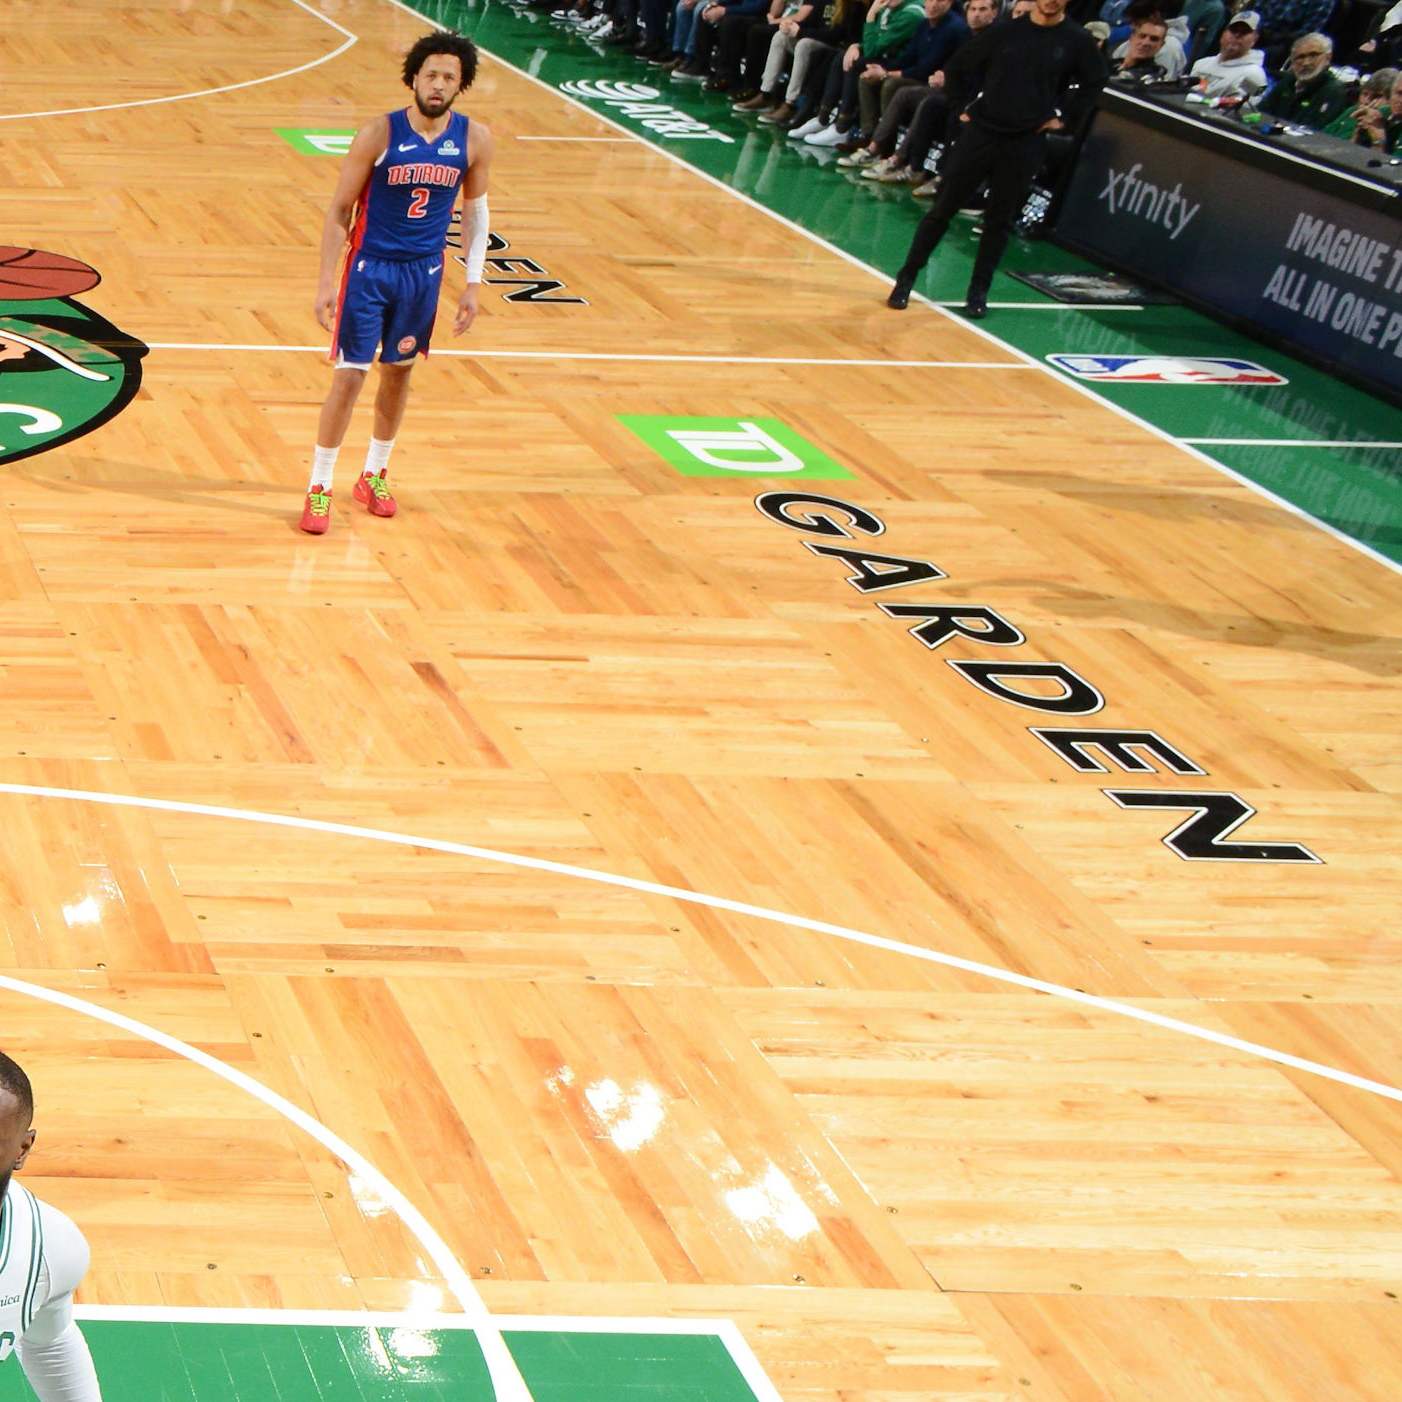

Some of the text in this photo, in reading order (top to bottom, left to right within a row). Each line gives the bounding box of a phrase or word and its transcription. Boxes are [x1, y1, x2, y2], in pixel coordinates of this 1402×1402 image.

[604, 100, 736, 143] AT&T
[388, 163, 460, 188] DETROIT
[407, 188, 430, 218] 2
[1098, 163, 1201, 240] xfinity
[1285, 212, 1390, 283] IMAGINE
[1262, 264, 1308, 311] ALL
[1303, 280, 1339, 323] IN
[1331, 292, 1387, 344] ONE
[665, 421, 1326, 865] TD GARDEN
